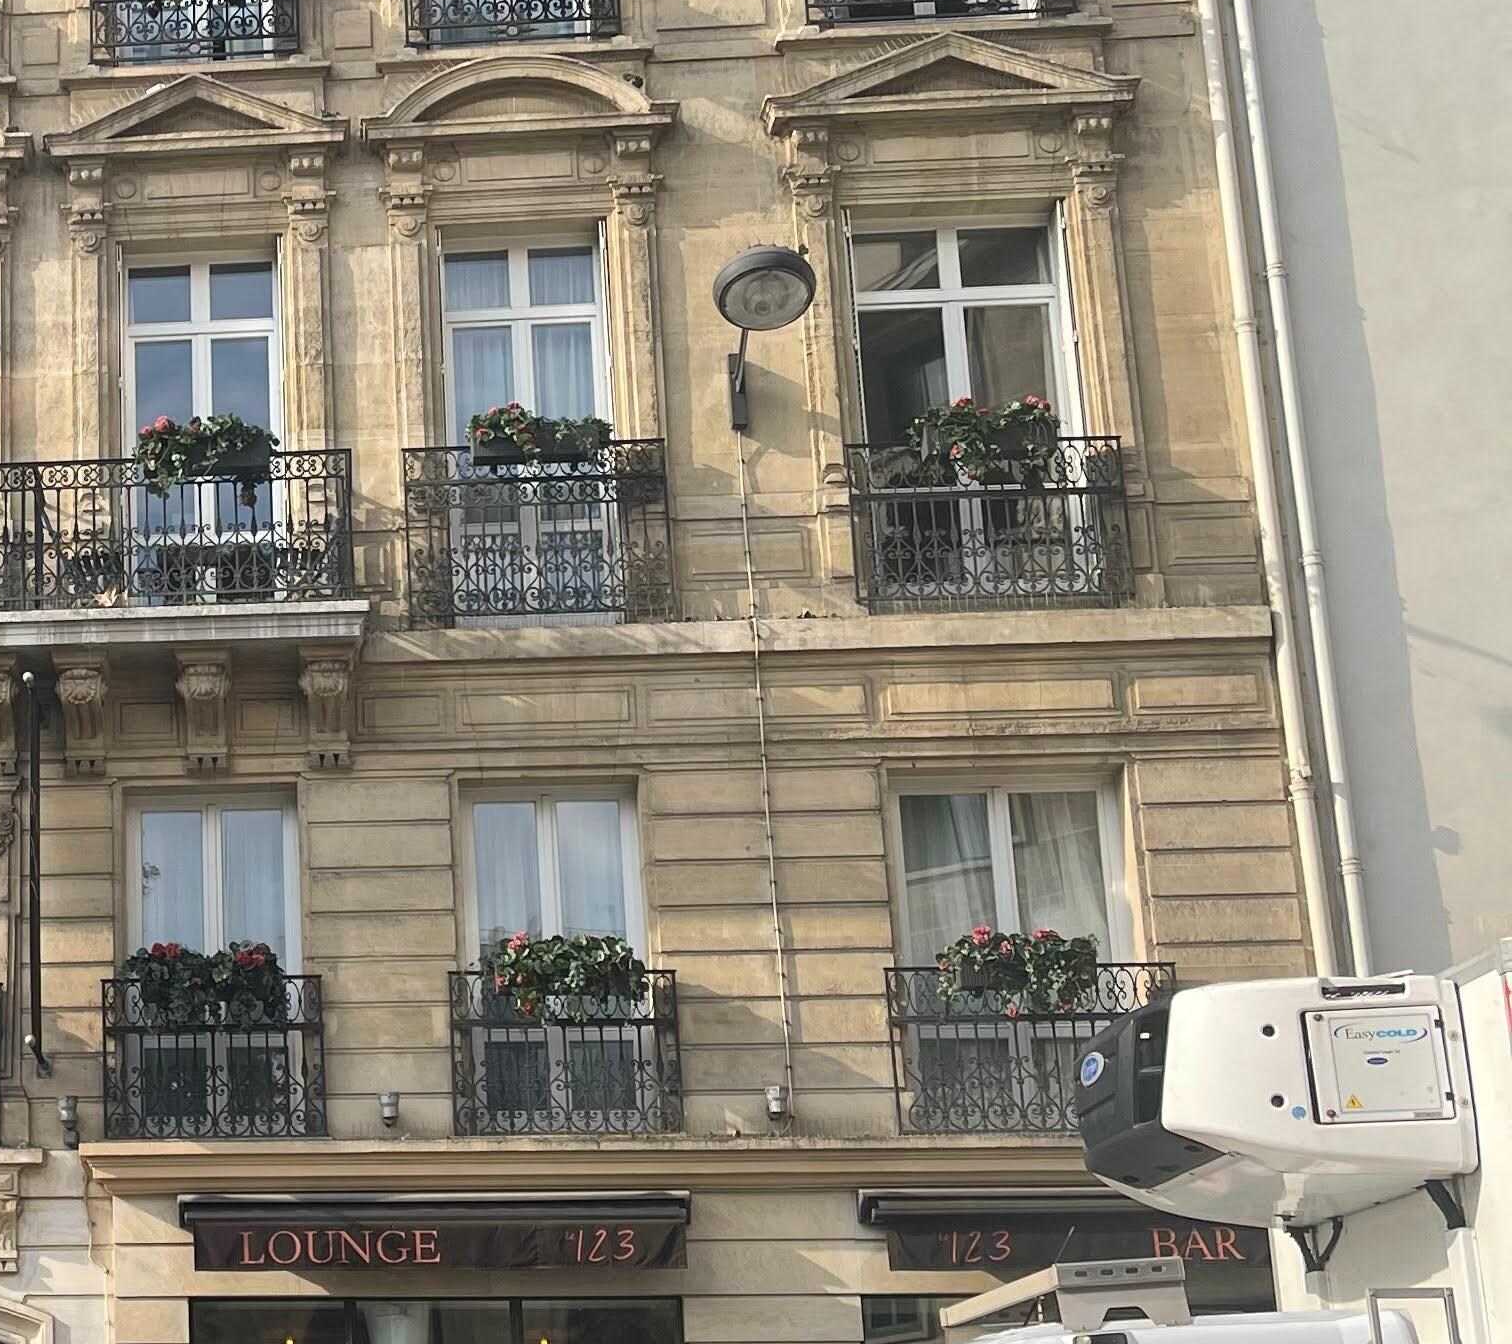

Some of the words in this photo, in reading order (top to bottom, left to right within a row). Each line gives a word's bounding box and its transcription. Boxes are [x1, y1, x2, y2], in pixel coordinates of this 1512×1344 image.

[1345, 1028, 1418, 1041] EasyCOLD
[240, 1229, 441, 1264] LOUNGE
[577, 1229, 635, 1263] 123
[951, 1231, 1011, 1264] 123
[1152, 1226, 1246, 1260] BAR
